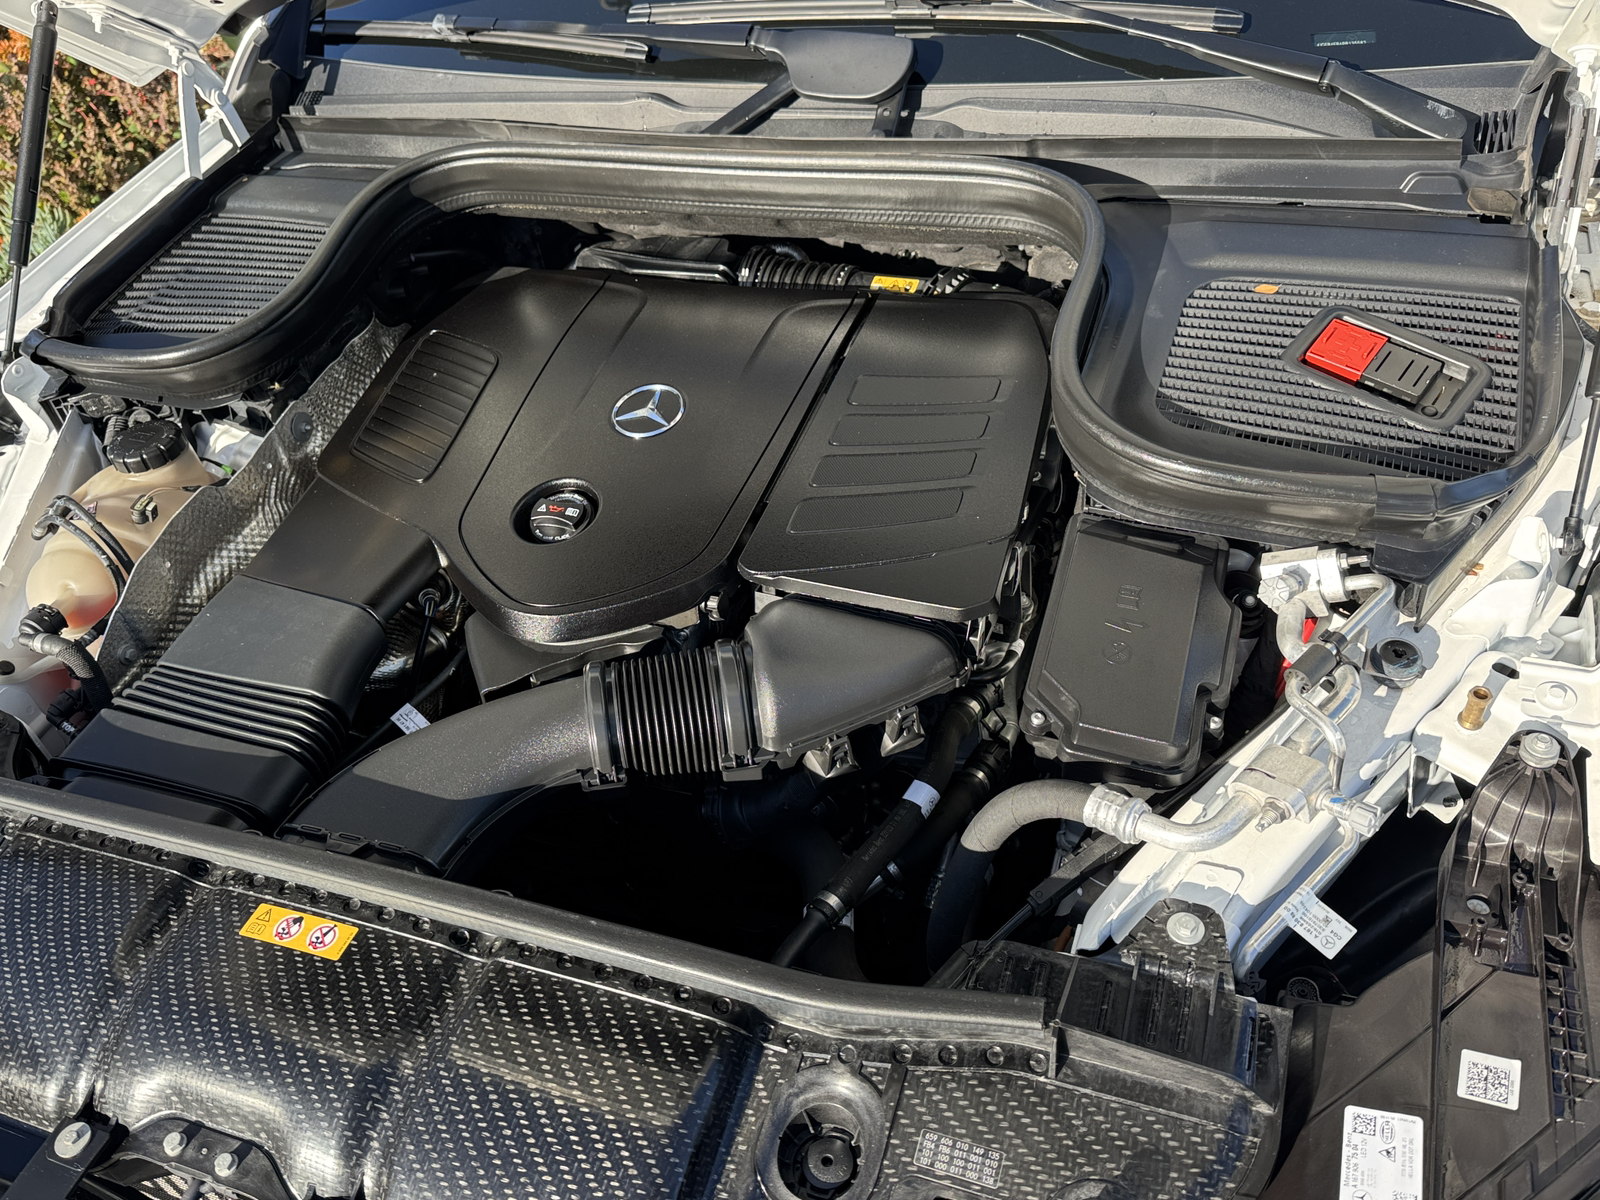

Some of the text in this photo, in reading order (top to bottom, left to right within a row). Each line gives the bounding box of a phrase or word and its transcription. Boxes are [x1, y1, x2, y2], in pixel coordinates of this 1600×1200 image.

[1330, 930, 1342, 940] CG4
[923, 1140, 998, 1168] FB4 FB6 011 001 010
[925, 1132, 1000, 1160] 659 606 010 149 135
[920, 1157, 994, 1185] 101 000 011 000 138
[922, 1149, 996, 1176] 101 100 100 011 001
